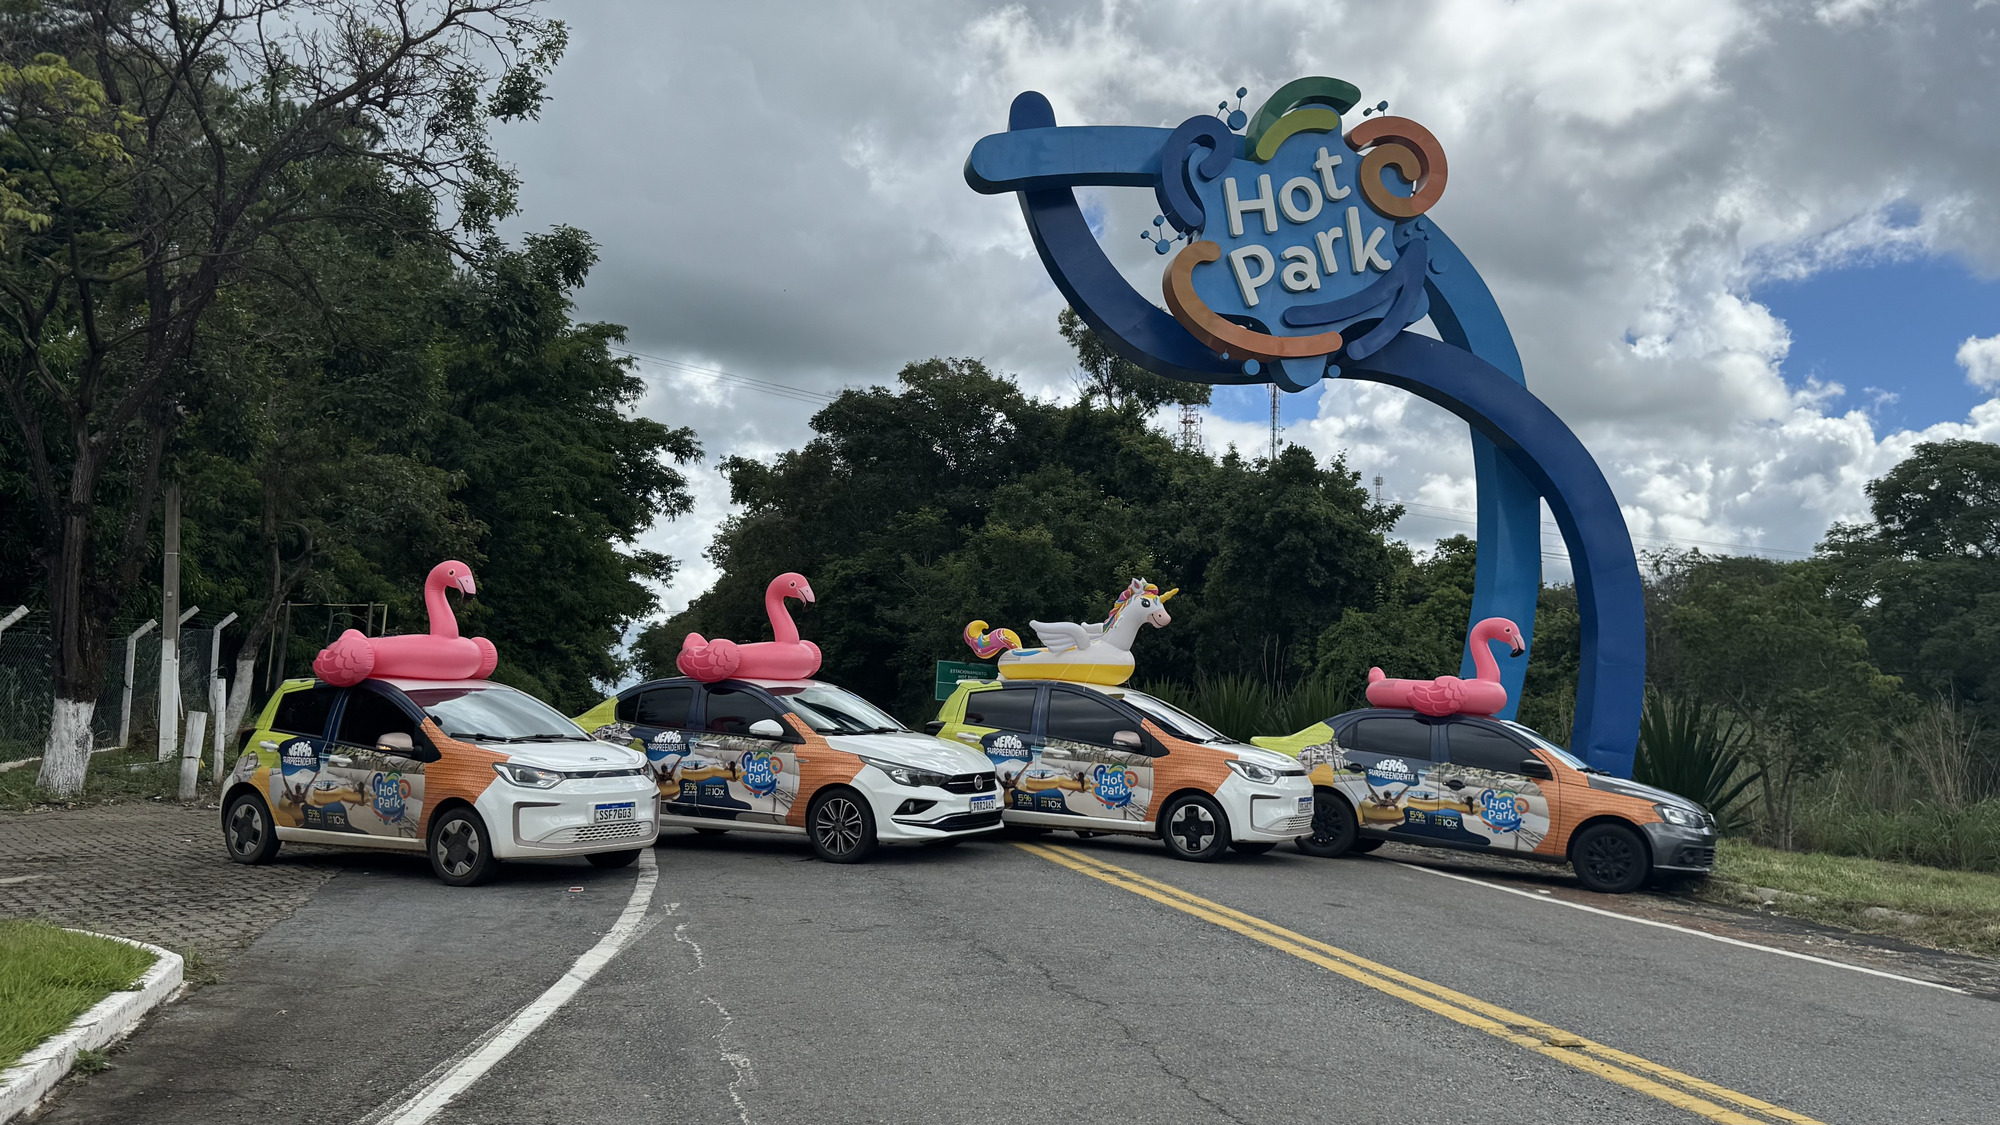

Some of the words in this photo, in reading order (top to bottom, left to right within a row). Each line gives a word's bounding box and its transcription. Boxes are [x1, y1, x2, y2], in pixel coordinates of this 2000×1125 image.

[1223, 147, 1351, 237] Hot
[1228, 207, 1392, 307] Park
[654, 730, 682, 743] VERÃO
[994, 734, 1022, 749] VERÃO
[289, 740, 312, 757] VERÃO
[648, 743, 686, 752] SURPREENDENTE
[987, 747, 1028, 757] SURPREENDENTE
[283, 756, 317, 766] SURPREENDENTE
[749, 761, 768, 772] Hot
[1376, 758, 1408, 773] VERÃO
[748, 771, 771, 783] Park
[1102, 774, 1122, 785] Hot
[1368, 769, 1415, 781] SURPREENDENTE
[379, 782, 397, 796] Hot
[712, 787, 725, 796] 10x
[1100, 783, 1126, 795] Park
[378, 797, 400, 808] Park
[1048, 800, 1062, 809] 10x
[1489, 799, 1512, 810] Hot
[1488, 809, 1516, 821] Park
[1443, 818, 1458, 827] 10x
